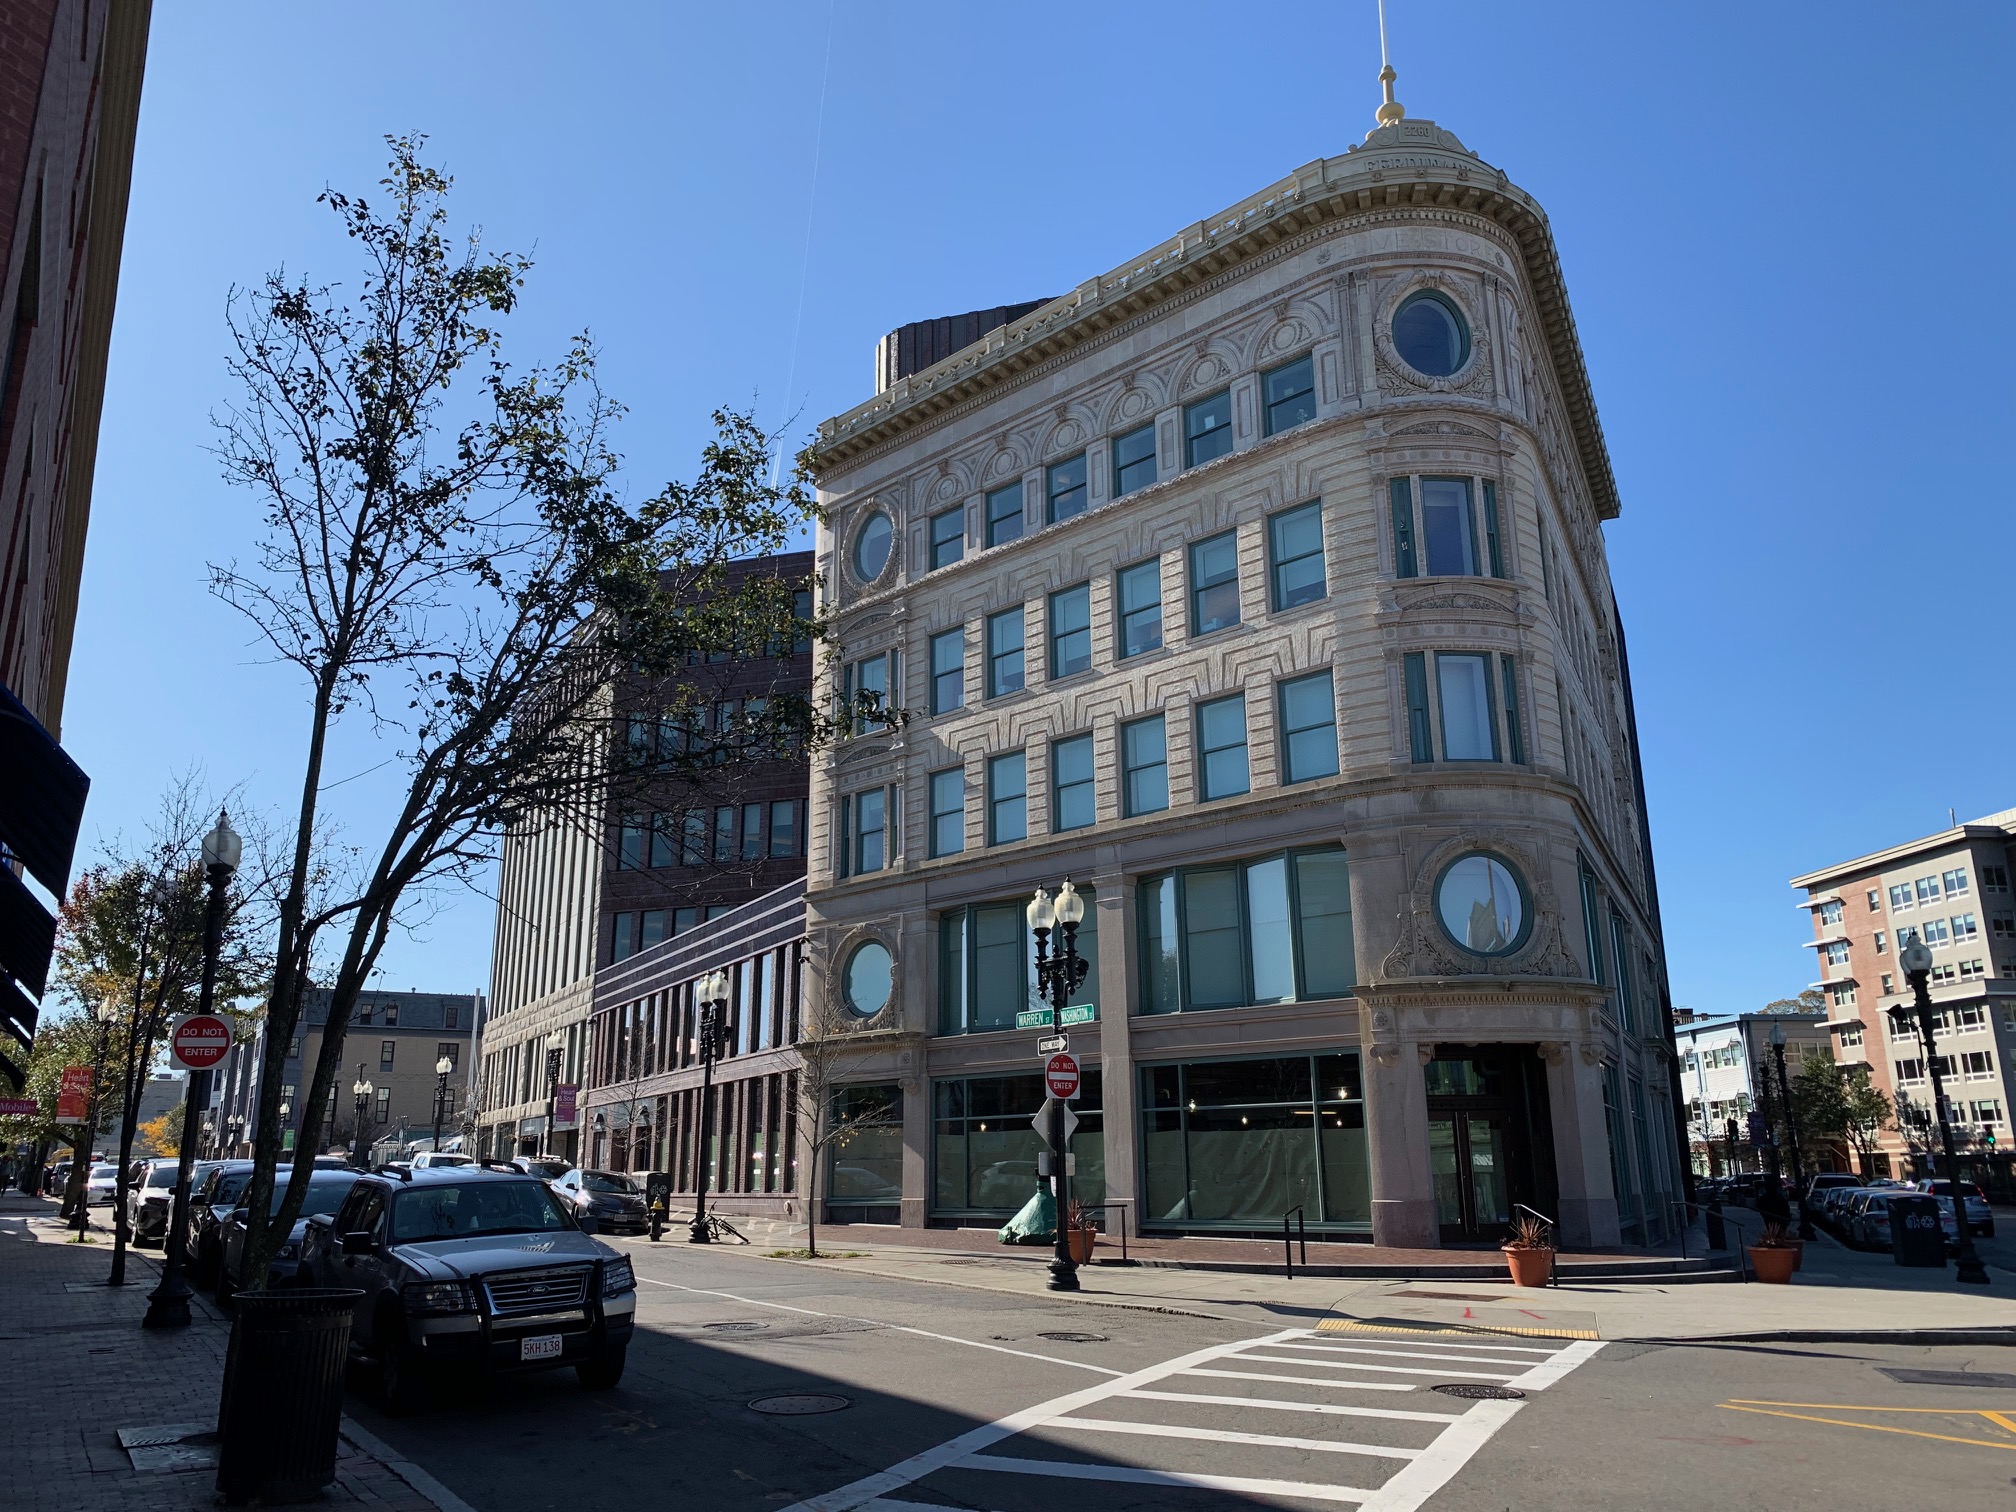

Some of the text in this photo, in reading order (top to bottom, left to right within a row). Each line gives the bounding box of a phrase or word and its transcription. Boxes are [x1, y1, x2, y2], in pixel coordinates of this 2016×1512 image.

[1404, 126, 1430, 137] 2260
[1018, 1012, 1044, 1027] WARREN
[1060, 1008, 1088, 1022] WASHINGTON
[182, 1028, 223, 1036] DO NOT
[1042, 1040, 1060, 1050] ONE WAY
[184, 1048, 218, 1056] ENTER
[67, 1073, 89, 1082] Heart
[0, 1102, 31, 1112] Mobile
[524, 1340, 560, 1355] 5KH 138
